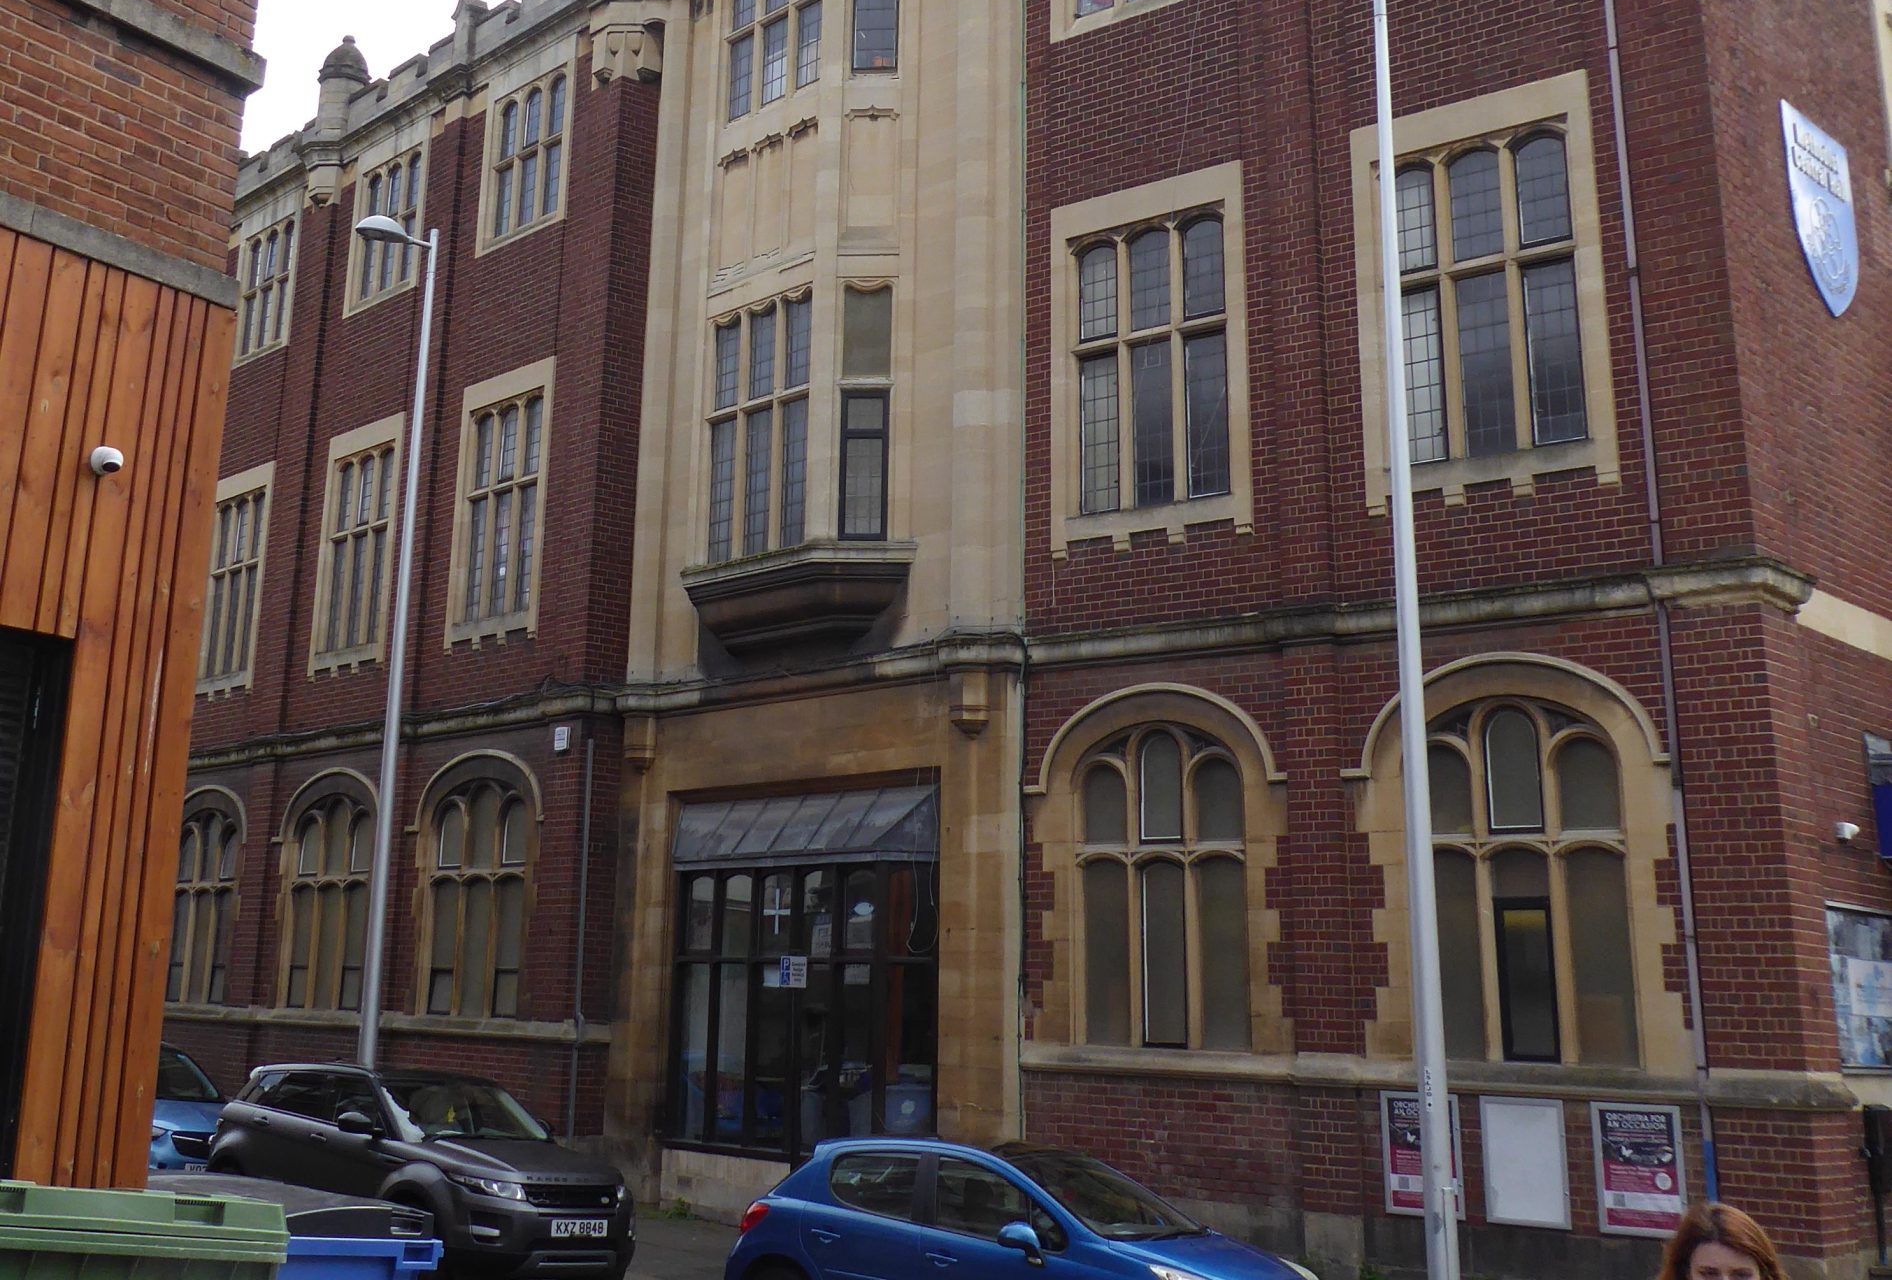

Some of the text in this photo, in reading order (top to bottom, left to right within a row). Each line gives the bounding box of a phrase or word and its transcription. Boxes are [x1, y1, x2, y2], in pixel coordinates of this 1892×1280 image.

[1650, 1115, 1666, 1123] FOR
[1607, 1120, 1666, 1130] AN OCCASION
[556, 1222, 577, 1234] KXZ
